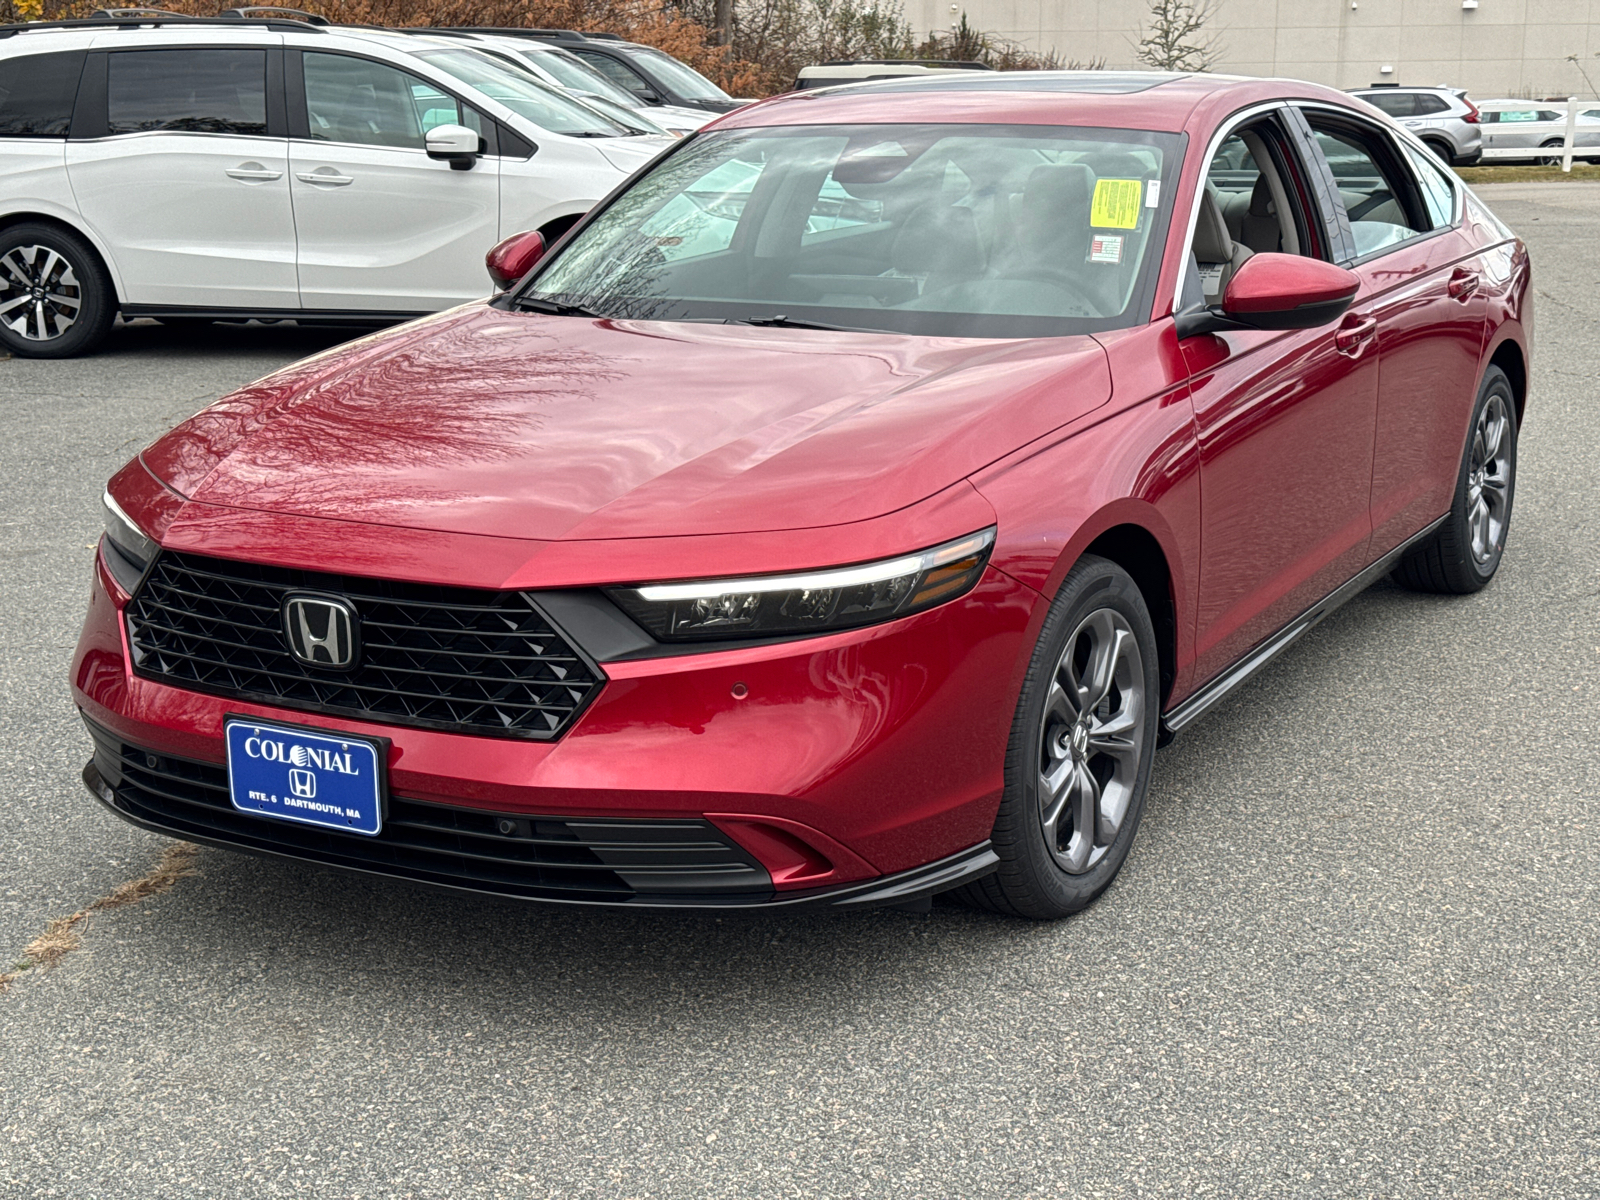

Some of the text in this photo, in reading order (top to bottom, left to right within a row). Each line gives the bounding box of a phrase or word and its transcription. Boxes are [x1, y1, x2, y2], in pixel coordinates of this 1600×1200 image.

[245, 737, 359, 776] COLONIAL
[249, 790, 361, 819] RTE. 6 DARTMOUTH, MA
